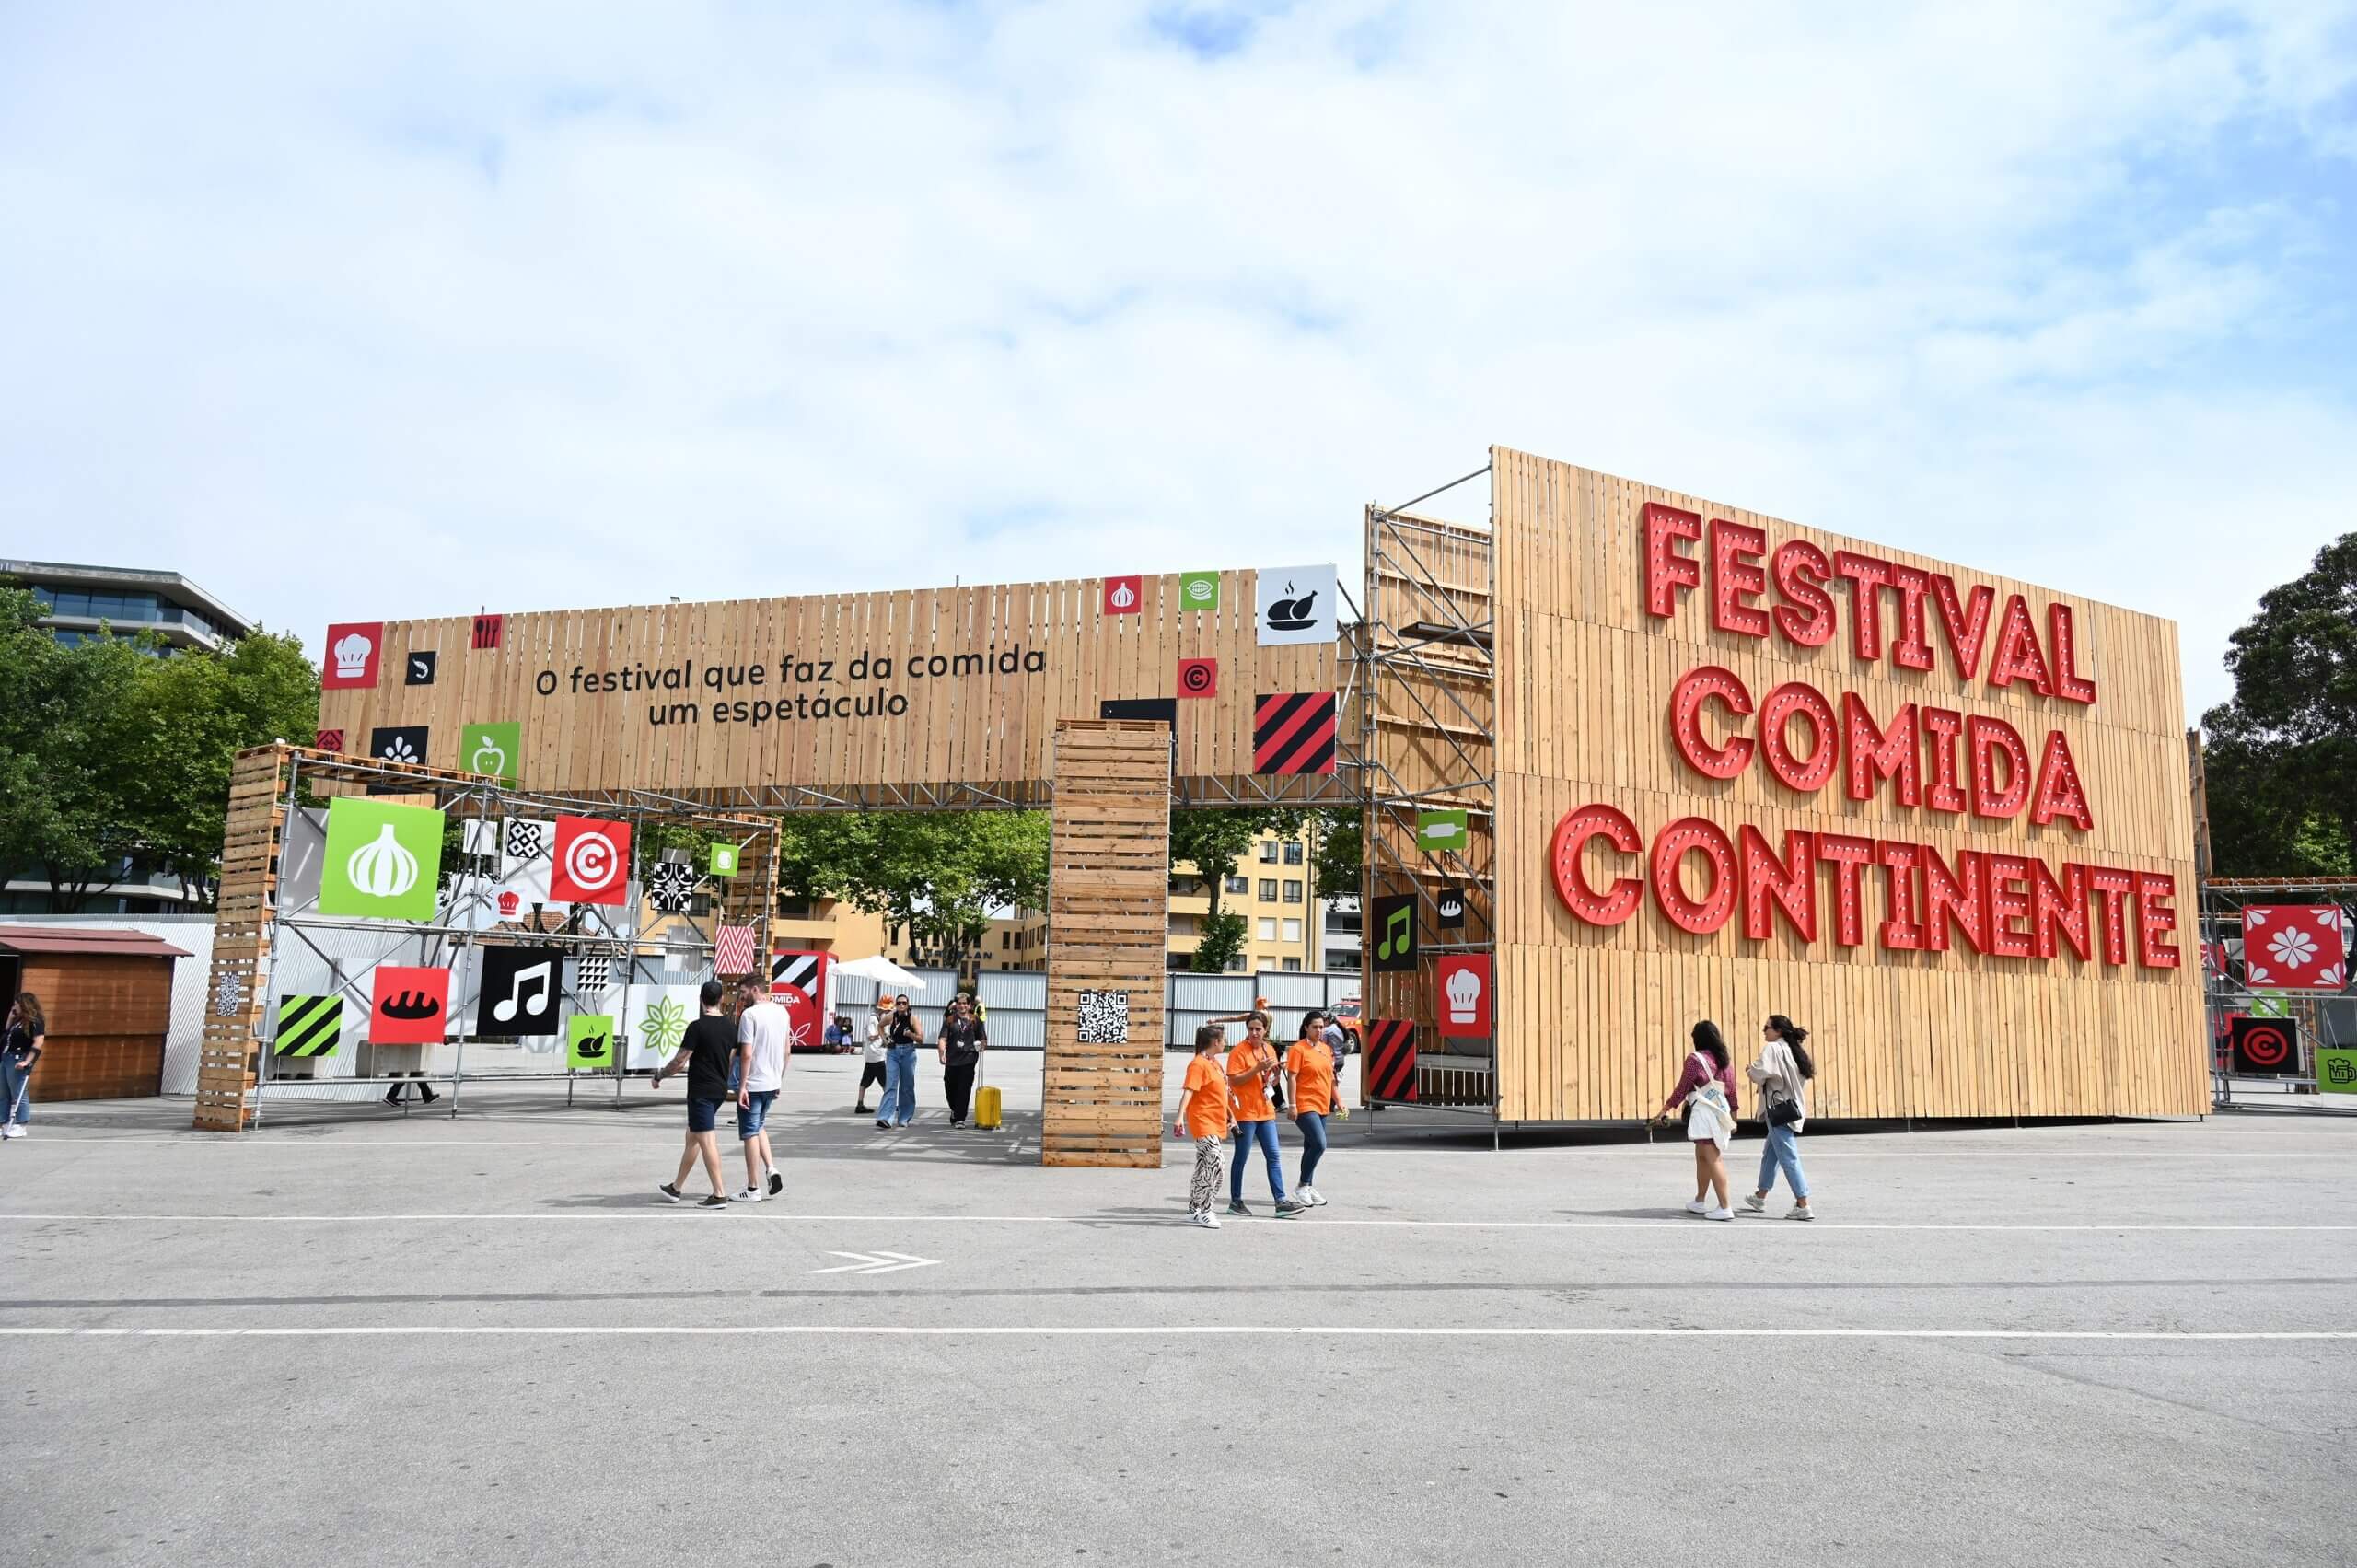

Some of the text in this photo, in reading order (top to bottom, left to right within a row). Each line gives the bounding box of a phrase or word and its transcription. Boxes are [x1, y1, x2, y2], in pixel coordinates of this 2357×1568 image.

[536, 643, 1045, 696] O festival que faz da comida
[1643, 501, 2096, 704] FESTIVAL
[649, 687, 908, 727] um espetáculo
[1670, 665, 2094, 830] COMIDA
[1550, 804, 2181, 969] CONTINENTE
